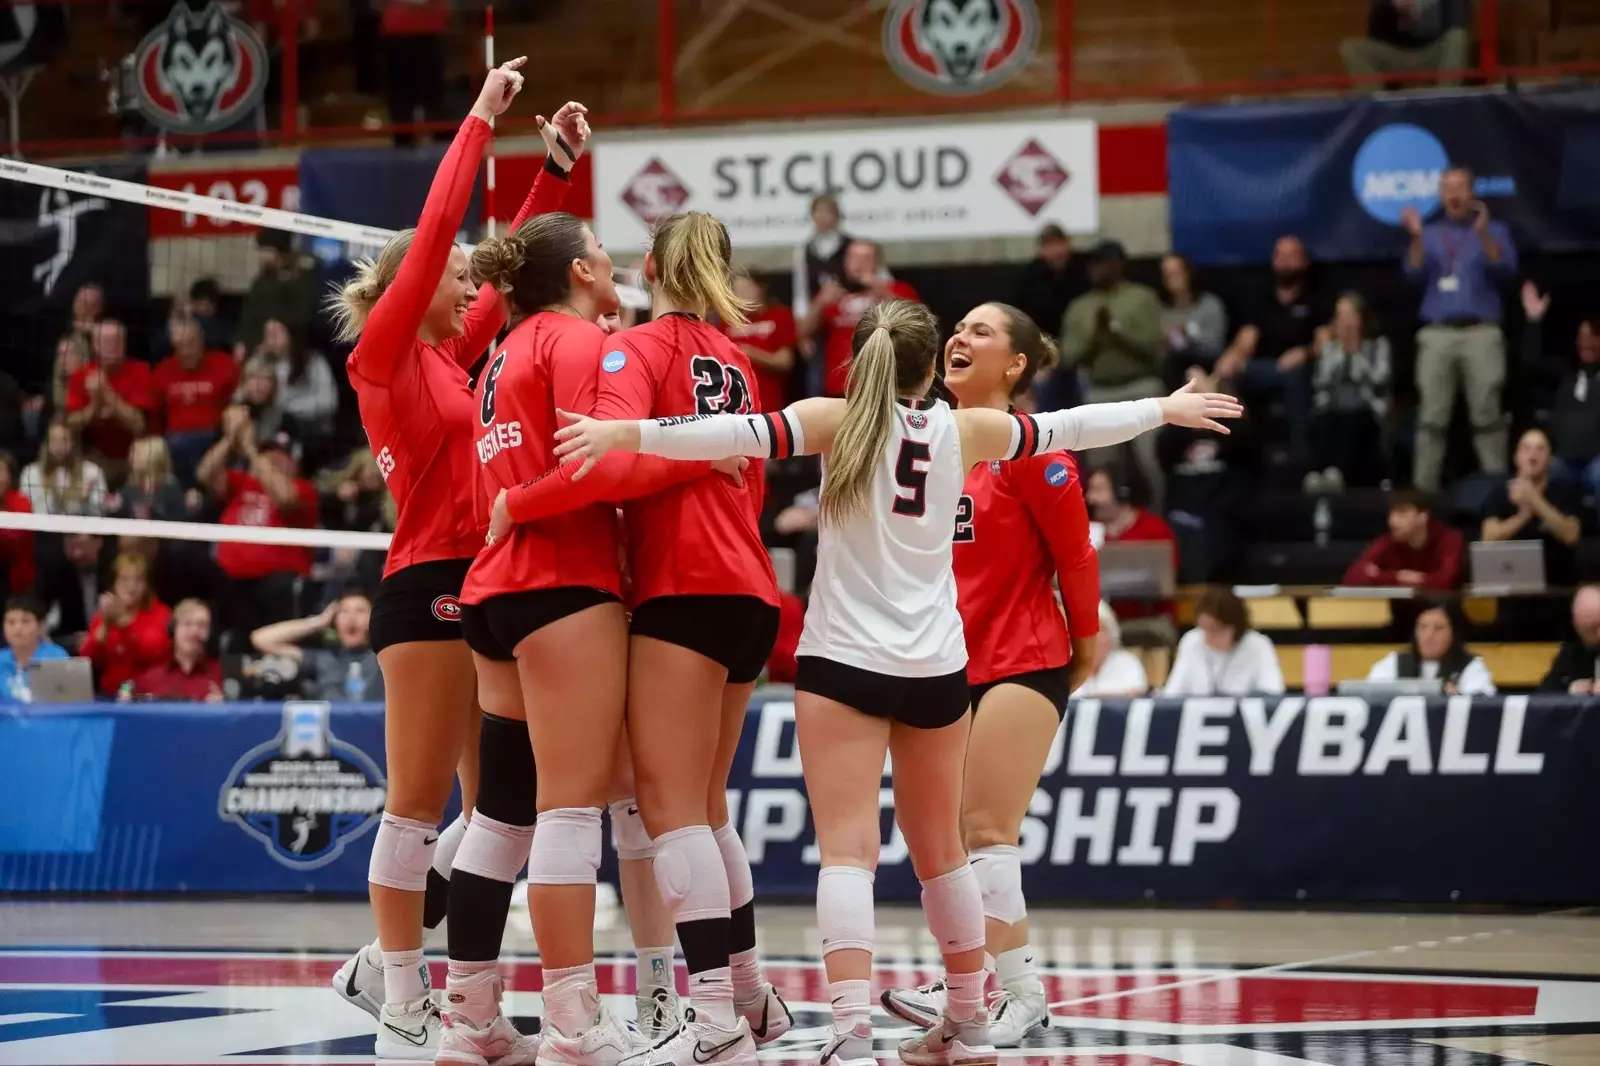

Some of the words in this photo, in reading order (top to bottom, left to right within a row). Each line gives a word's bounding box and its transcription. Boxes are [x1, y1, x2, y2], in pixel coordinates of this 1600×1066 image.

[481, 349, 507, 428] 8
[892, 438, 932, 518] 5
[1049, 469, 1068, 484] NCAA
[952, 494, 976, 543] 2
